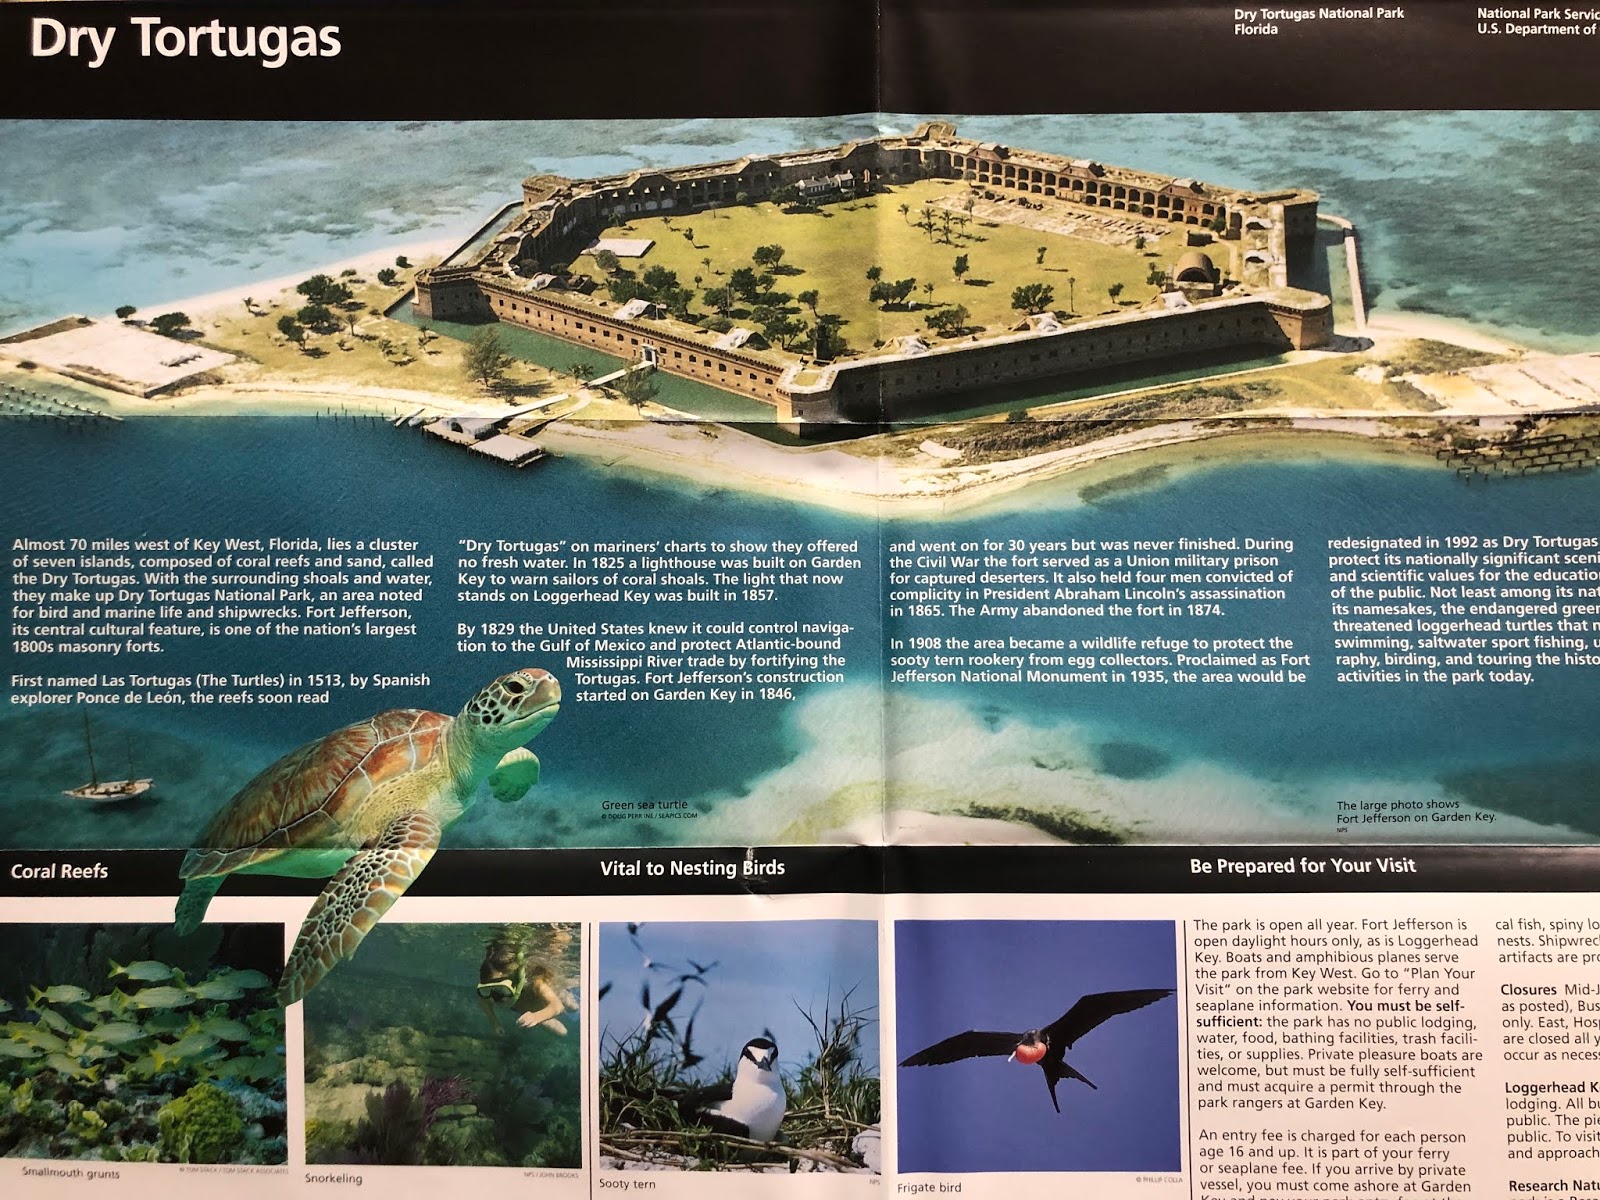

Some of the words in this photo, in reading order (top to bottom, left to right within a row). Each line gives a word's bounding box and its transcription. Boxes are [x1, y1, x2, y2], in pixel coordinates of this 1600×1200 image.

[1234, 9, 1257, 23] Dry
[1260, 8, 1316, 22] Tortugas
[1319, 7, 1373, 19] National
[1377, 7, 1405, 19] Park
[1477, 7, 1530, 19] National
[1534, 8, 1561, 19] Park
[1234, 23, 1278, 35] Florida
[1478, 23, 1502, 34] U.S.
[1505, 23, 1580, 37] Department
[1583, 23, 1597, 35] of
[32, 17, 116, 68] Dry
[130, 17, 341, 68] Tortugas
[12, 538, 66, 551] Almost
[70, 538, 87, 551] 70
[92, 538, 130, 551] miles
[134, 539, 170, 551] west
[173, 538, 190, 551] of
[193, 538, 221, 554] Key
[224, 538, 264, 552] West,
[269, 538, 322, 552] Florida,
[327, 538, 352, 550] lies
[356, 541, 365, 550] a
[369, 538, 419, 551] cluster
[570, 543, 589, 552] on
[664, 540, 707, 553] charts
[710, 541, 726, 552] to
[729, 540, 768, 552] show
[771, 540, 803, 555] they
[807, 540, 858, 552] offered
[1328, 536, 1422, 552] redesignated
[1426, 539, 1439, 548] in
[1444, 536, 1478, 548] 1992
[1482, 539, 1499, 548] as
[1503, 536, 1529, 551] Dry
[1532, 535, 1599, 551] Tortugas
[12, 555, 29, 568] of
[32, 558, 76, 568] seven
[80, 555, 135, 569] islands,
[139, 555, 212, 571] composed
[216, 555, 232, 567] of
[236, 555, 271, 567] coral
[275, 555, 310, 567] reefs
[314, 555, 342, 567] and
[347, 555, 386, 569] sand,
[390, 555, 434, 568] called
[457, 589, 506, 602] stands
[510, 592, 529, 602] on
[533, 589, 619, 605] Loggerhead
[624, 590, 651, 605] Key
[654, 592, 683, 602] was
[687, 589, 720, 601] built
[724, 592, 737, 601] in
[742, 589, 778, 601] 1857.
[890, 588, 962, 603] complicity
[966, 588, 979, 600] in
[983, 587, 1050, 600] President
[1054, 587, 1120, 600] Abraham
[1190, 588, 1286, 600] assassination
[891, 670, 956, 682] Jefferson
[961, 670, 1022, 682] National
[1027, 670, 1108, 683] Monument
[1112, 673, 1125, 682] in
[1130, 670, 1169, 684] 1935,
[1172, 670, 1197, 683] the
[1201, 673, 1233, 683] area
[1237, 670, 1284, 683] would
[1288, 670, 1306, 683] be
[1337, 669, 1401, 682] activities
[1405, 669, 1419, 682] in
[1422, 669, 1448, 682] the
[1452, 669, 1485, 685] park
[1488, 669, 1534, 685] today.
[602, 800, 634, 810] Green
[637, 802, 655, 810] sea
[658, 800, 688, 810] turtle
[1336, 801, 1357, 811] The
[1360, 800, 1388, 813] large
[1390, 799, 1424, 812] photo
[1426, 799, 1460, 809] shows
[1337, 814, 1359, 824] Fort
[1361, 812, 1411, 824] Jefferson
[1414, 814, 1428, 823] on
[1431, 811, 1471, 822] Garden
[1475, 812, 1498, 824] Key.
[11, 863, 56, 879] Coral
[61, 862, 108, 879] Reefs
[600, 860, 641, 876] Vital
[646, 861, 665, 876] to
[670, 859, 737, 879] Nesting
[743, 859, 785, 875] Birds
[1190, 859, 1212, 873] Be
[1217, 857, 1295, 877] Prepared
[1299, 857, 1326, 873] for
[1330, 858, 1372, 873] Your
[1376, 857, 1417, 873] Visit
[1193, 919, 1218, 931] The
[1222, 919, 1252, 933] park
[1256, 919, 1266, 931] is
[1269, 921, 1303, 933] open
[1307, 918, 1322, 930] all
[1326, 921, 1357, 933] year.
[1362, 918, 1389, 930] Fort
[1392, 918, 1453, 930] Jefferson
[1457, 921, 1467, 930] is
[1495, 918, 1514, 930] cal
[1517, 918, 1545, 932] fish,
[1549, 918, 1584, 933] spiny
[1498, 950, 1553, 963] artifacts
[1557, 953, 1578, 963] are
[1500, 983, 1557, 996] Closures
[1196, 1015, 1262, 1028] sufficient:
[1266, 1015, 1289, 1028] the
[1293, 1015, 1323, 1030] park
[1327, 1015, 1350, 1028] has
[1354, 1018, 1372, 1028] no
[1376, 1016, 1417, 1030] public
[1421, 1016, 1477, 1031] lodging,
[1505, 1081, 1586, 1097] Loggerhead
[22, 1166, 84, 1178] Smallmouth
[86, 1171, 120, 1181] grunts
[305, 1173, 363, 1186] Snorkeling
[599, 1178, 630, 1191] Sooty
[633, 1180, 656, 1189] tern
[897, 1182, 936, 1195] Frigate
[939, 1182, 962, 1193] bird
[1509, 1179, 1568, 1192] Research
